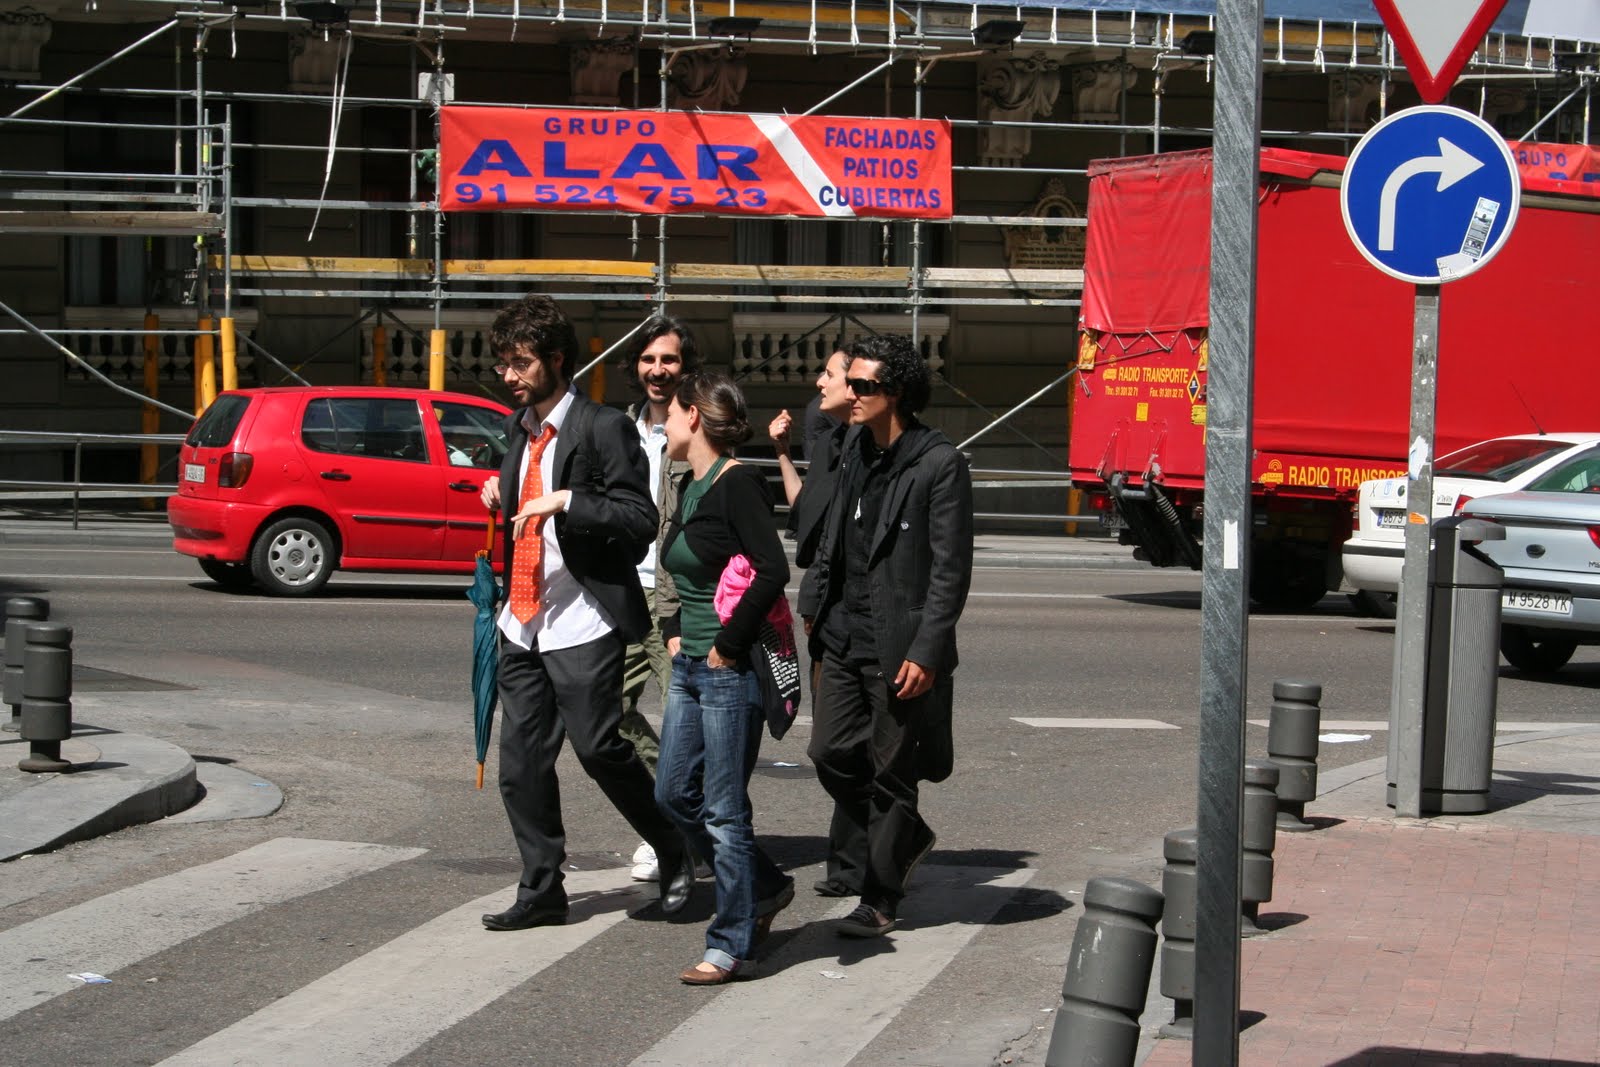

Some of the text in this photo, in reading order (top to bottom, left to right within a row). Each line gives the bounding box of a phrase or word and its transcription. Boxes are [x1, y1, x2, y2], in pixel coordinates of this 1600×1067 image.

[543, 117, 656, 137] GRUPO
[824, 126, 937, 151] FACHADAS
[457, 139, 762, 181] ALAR
[843, 157, 919, 179] PATIOS
[1510, 150, 1568, 167] RUPO
[454, 182, 768, 208] 91 524 75 23
[818, 185, 942, 209] CUBIERTAS
[1118, 366, 1190, 384] RADIO TRANSPORTE
[1288, 465, 1330, 486] RADIO
[1508, 591, 1569, 612] M 9528 YK
